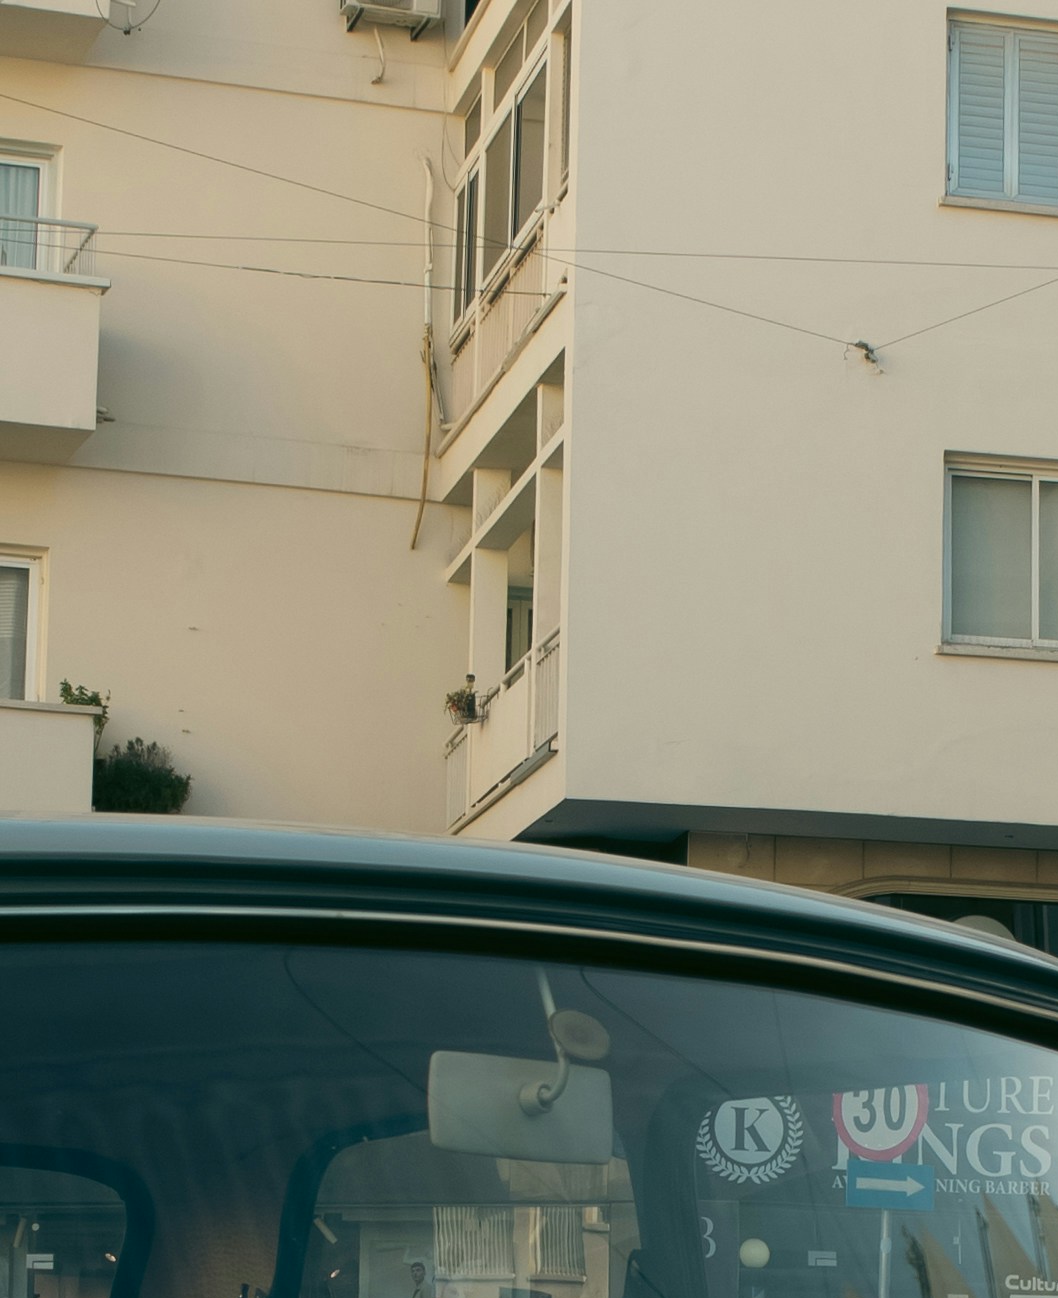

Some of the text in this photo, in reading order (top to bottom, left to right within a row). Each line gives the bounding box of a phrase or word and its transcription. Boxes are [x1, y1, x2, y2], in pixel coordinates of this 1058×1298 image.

[730, 1106, 771, 1152] K
[853, 1086, 907, 1133] 30
[985, 1178, 1051, 1196] BARBER
